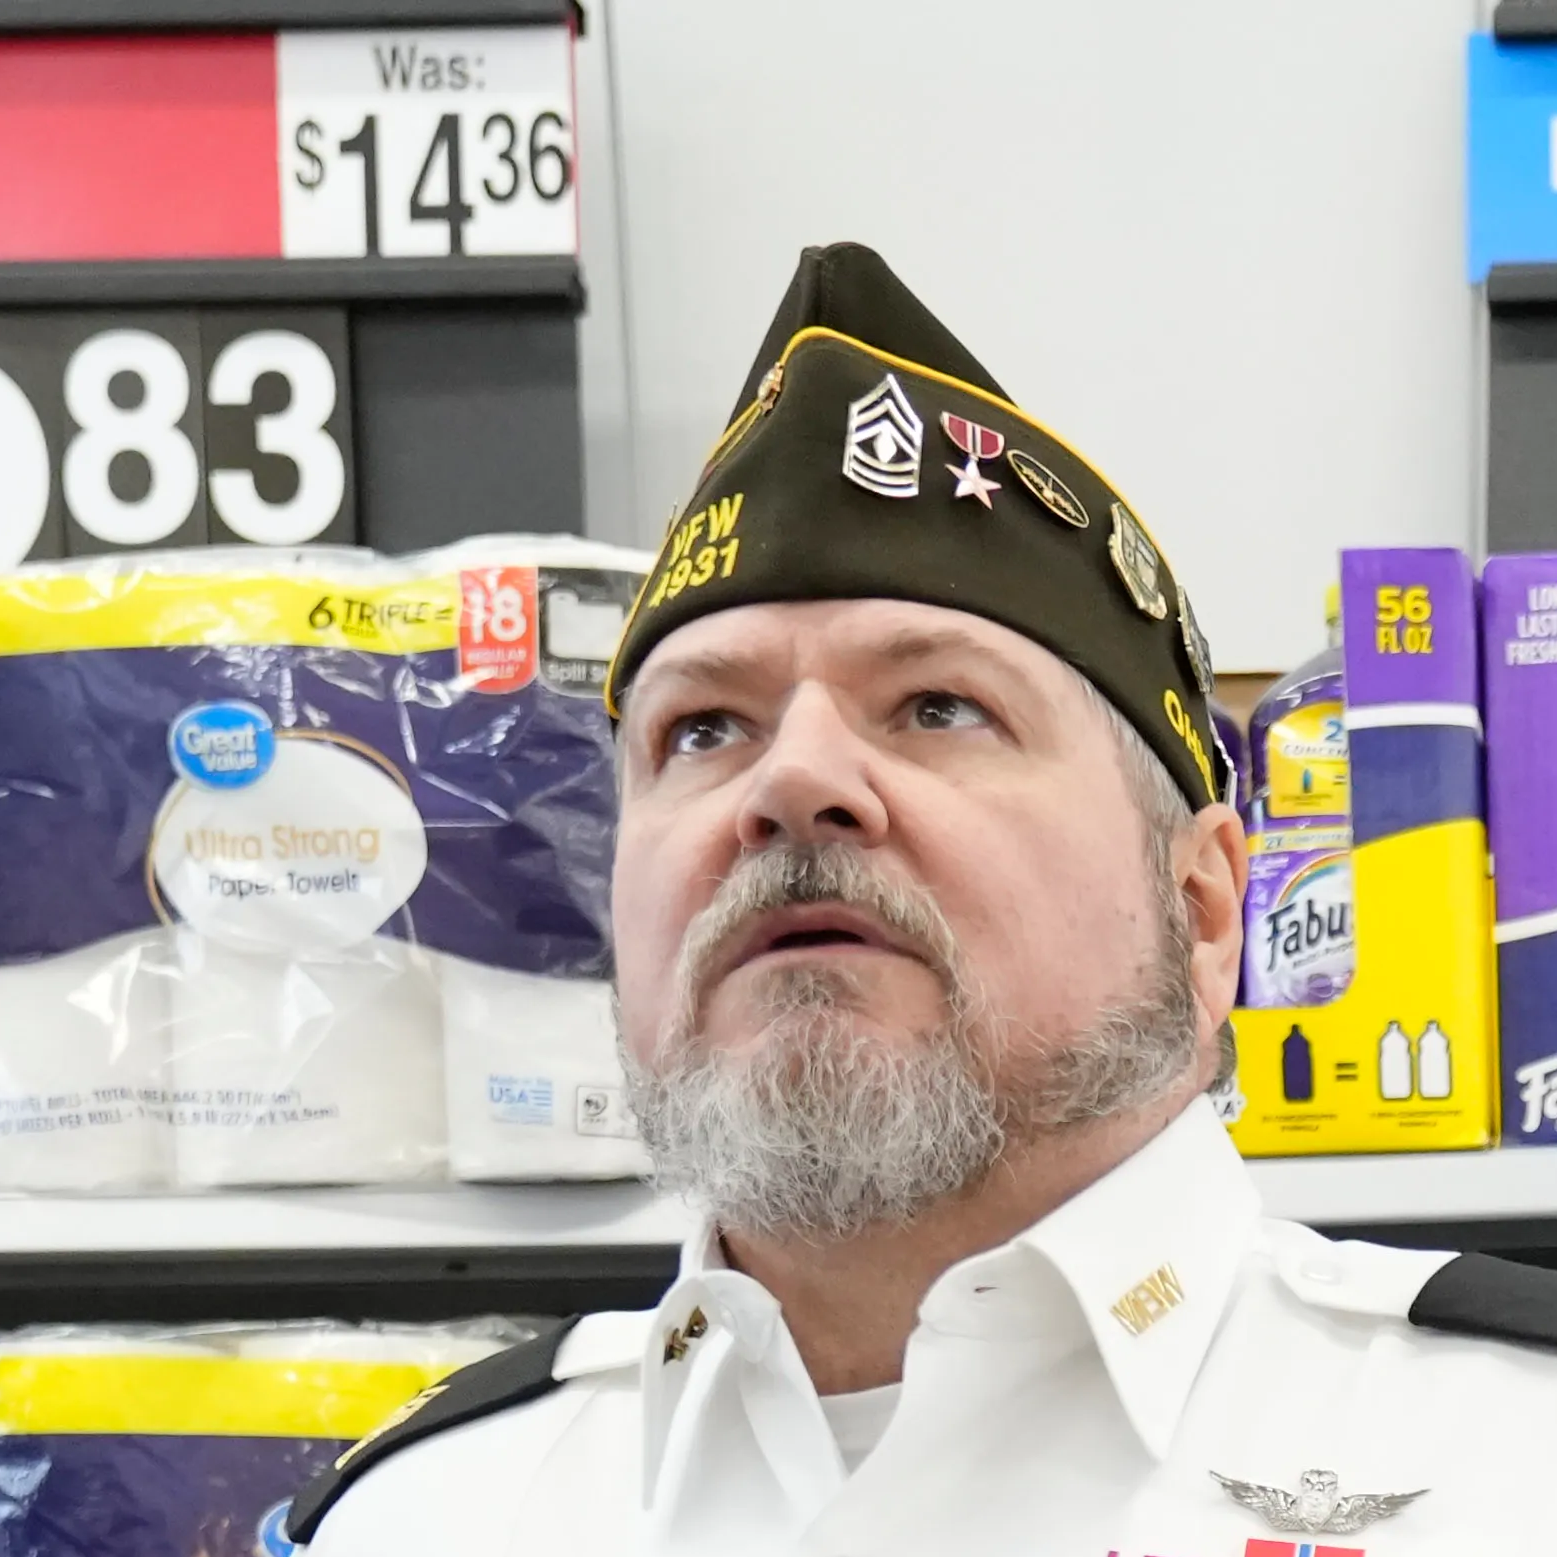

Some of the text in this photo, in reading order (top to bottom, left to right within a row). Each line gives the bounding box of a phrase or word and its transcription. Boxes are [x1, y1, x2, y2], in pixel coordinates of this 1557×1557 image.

[374, 42, 489, 93] Was:
[668, 491, 745, 567] VFW
[308, 586, 528, 644] 6 TRIPLE 18
[1376, 586, 1432, 624] 56
[1376, 625, 1433, 654] FL OZ
[181, 725, 257, 756] Great
[202, 747, 258, 775] Value
[184, 824, 382, 869] Ultra Strong
[207, 873, 275, 900] Pape
[1265, 900, 1354, 974] Fabu
[1109, 1260, 1187, 1339] VFW
